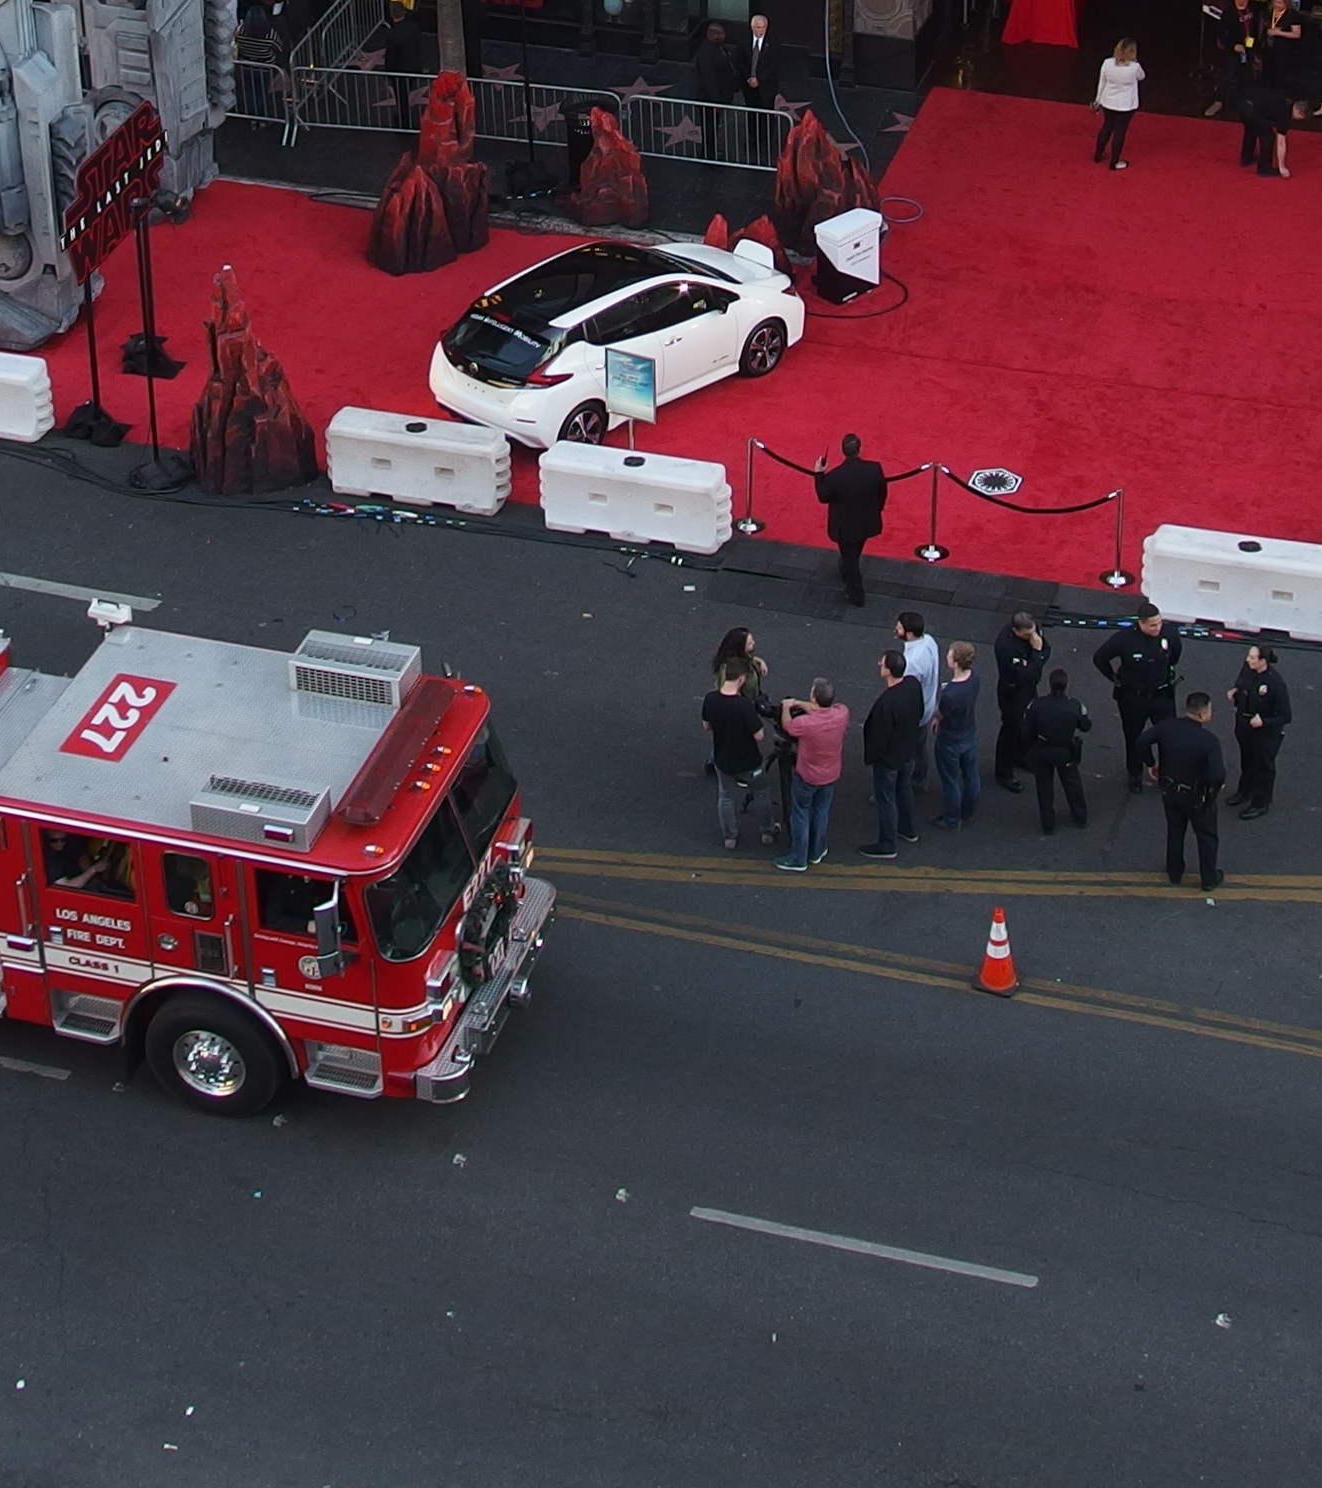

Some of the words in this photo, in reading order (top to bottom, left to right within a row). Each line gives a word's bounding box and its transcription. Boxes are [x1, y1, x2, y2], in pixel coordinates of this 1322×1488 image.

[64, 100, 161, 227] STAR
[60, 216, 86, 251] THE
[96, 171, 130, 213] LAST
[139, 130, 169, 170] JEDI
[80, 681, 158, 754] 227
[55, 907, 78, 922] LOS
[81, 913, 132, 932] ANGELES
[66, 928, 92, 943] FIRE
[95, 934, 126, 950] DEPT.
[68, 956, 110, 972] CLASS
[113, 964, 120, 974] 1
